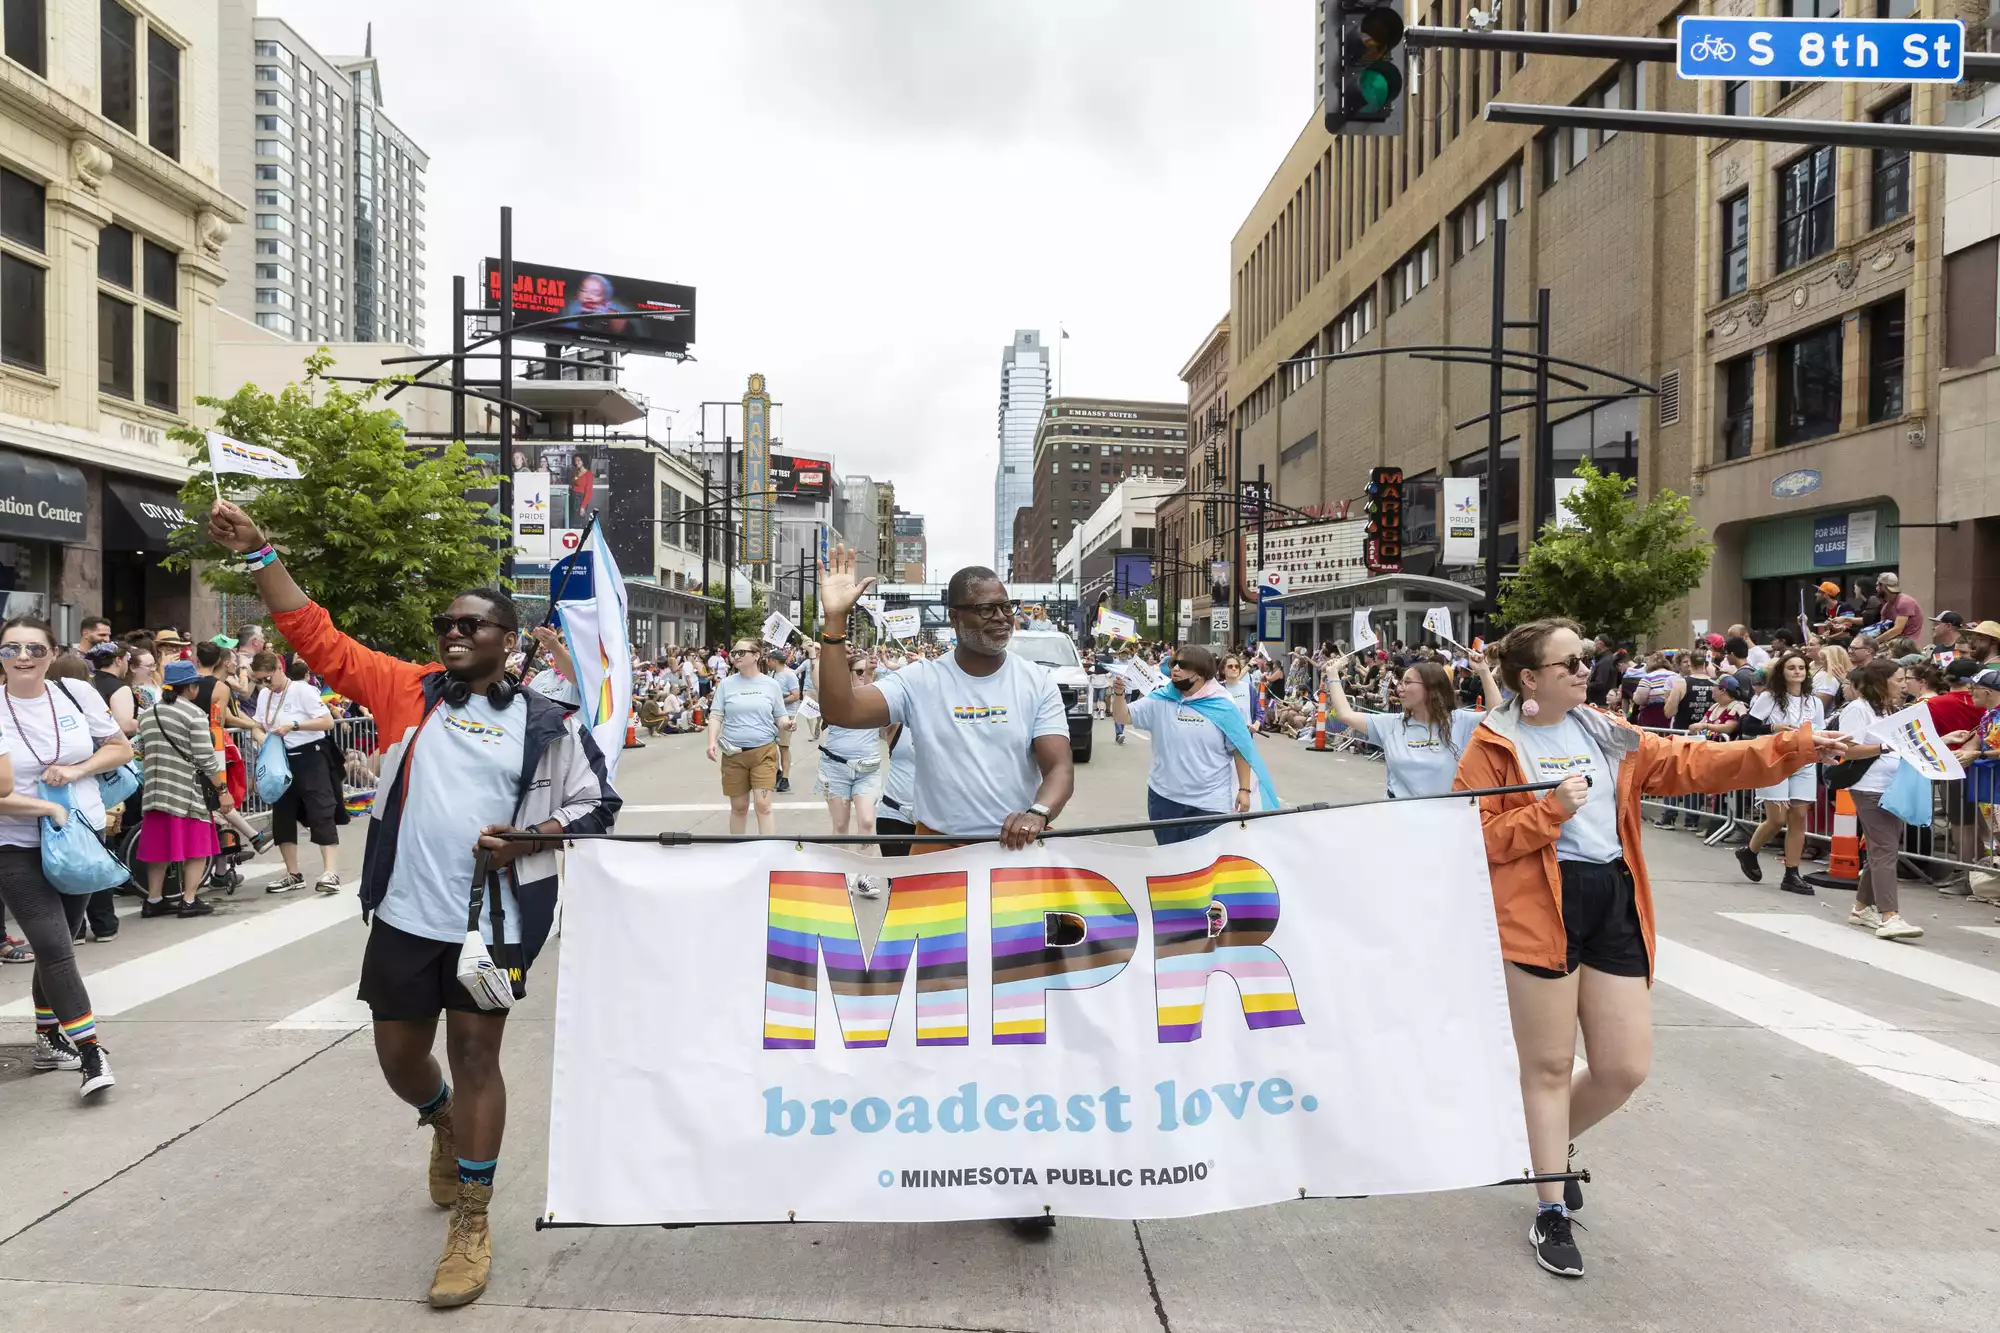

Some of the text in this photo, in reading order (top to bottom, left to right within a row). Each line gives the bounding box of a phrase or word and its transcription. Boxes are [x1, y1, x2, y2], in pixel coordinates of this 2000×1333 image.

[1749, 32, 1951, 68] S 8th St
[490, 272, 566, 296] DJA CAT
[512, 292, 542, 304] CARLET
[544, 297, 565, 308] TOUR
[530, 304, 559, 313] SPICE
[1069, 409, 1106, 418] EMBASSY
[120, 422, 160, 447] CITY PLACE
[750, 402, 762, 554] PANTAGES
[778, 469, 790, 478] TEST
[38, 500, 83, 523] Center
[140, 502, 166, 520] CITY
[1380, 472, 1401, 556] MARUSO
[1815, 526, 1846, 538] FOR SALE
[1265, 538, 1295, 549] PRIDE
[1302, 534, 1333, 544] PARTY
[1814, 541, 1846, 553] OR LEASE
[1265, 546, 1312, 561] MODESTEP
[1320, 548, 1326, 556] X
[1277, 557, 1364, 571] TOKYO MACHINE
[1302, 573, 1340, 583] PARADE
[1214, 620, 1228, 629] 25
[762, 854, 1306, 1050] MPR
[762, 1077, 1318, 1138] broadcast love.
[900, 1168, 1038, 1189] MINNESOTA
[1046, 1166, 1133, 1188] PUBLIC
